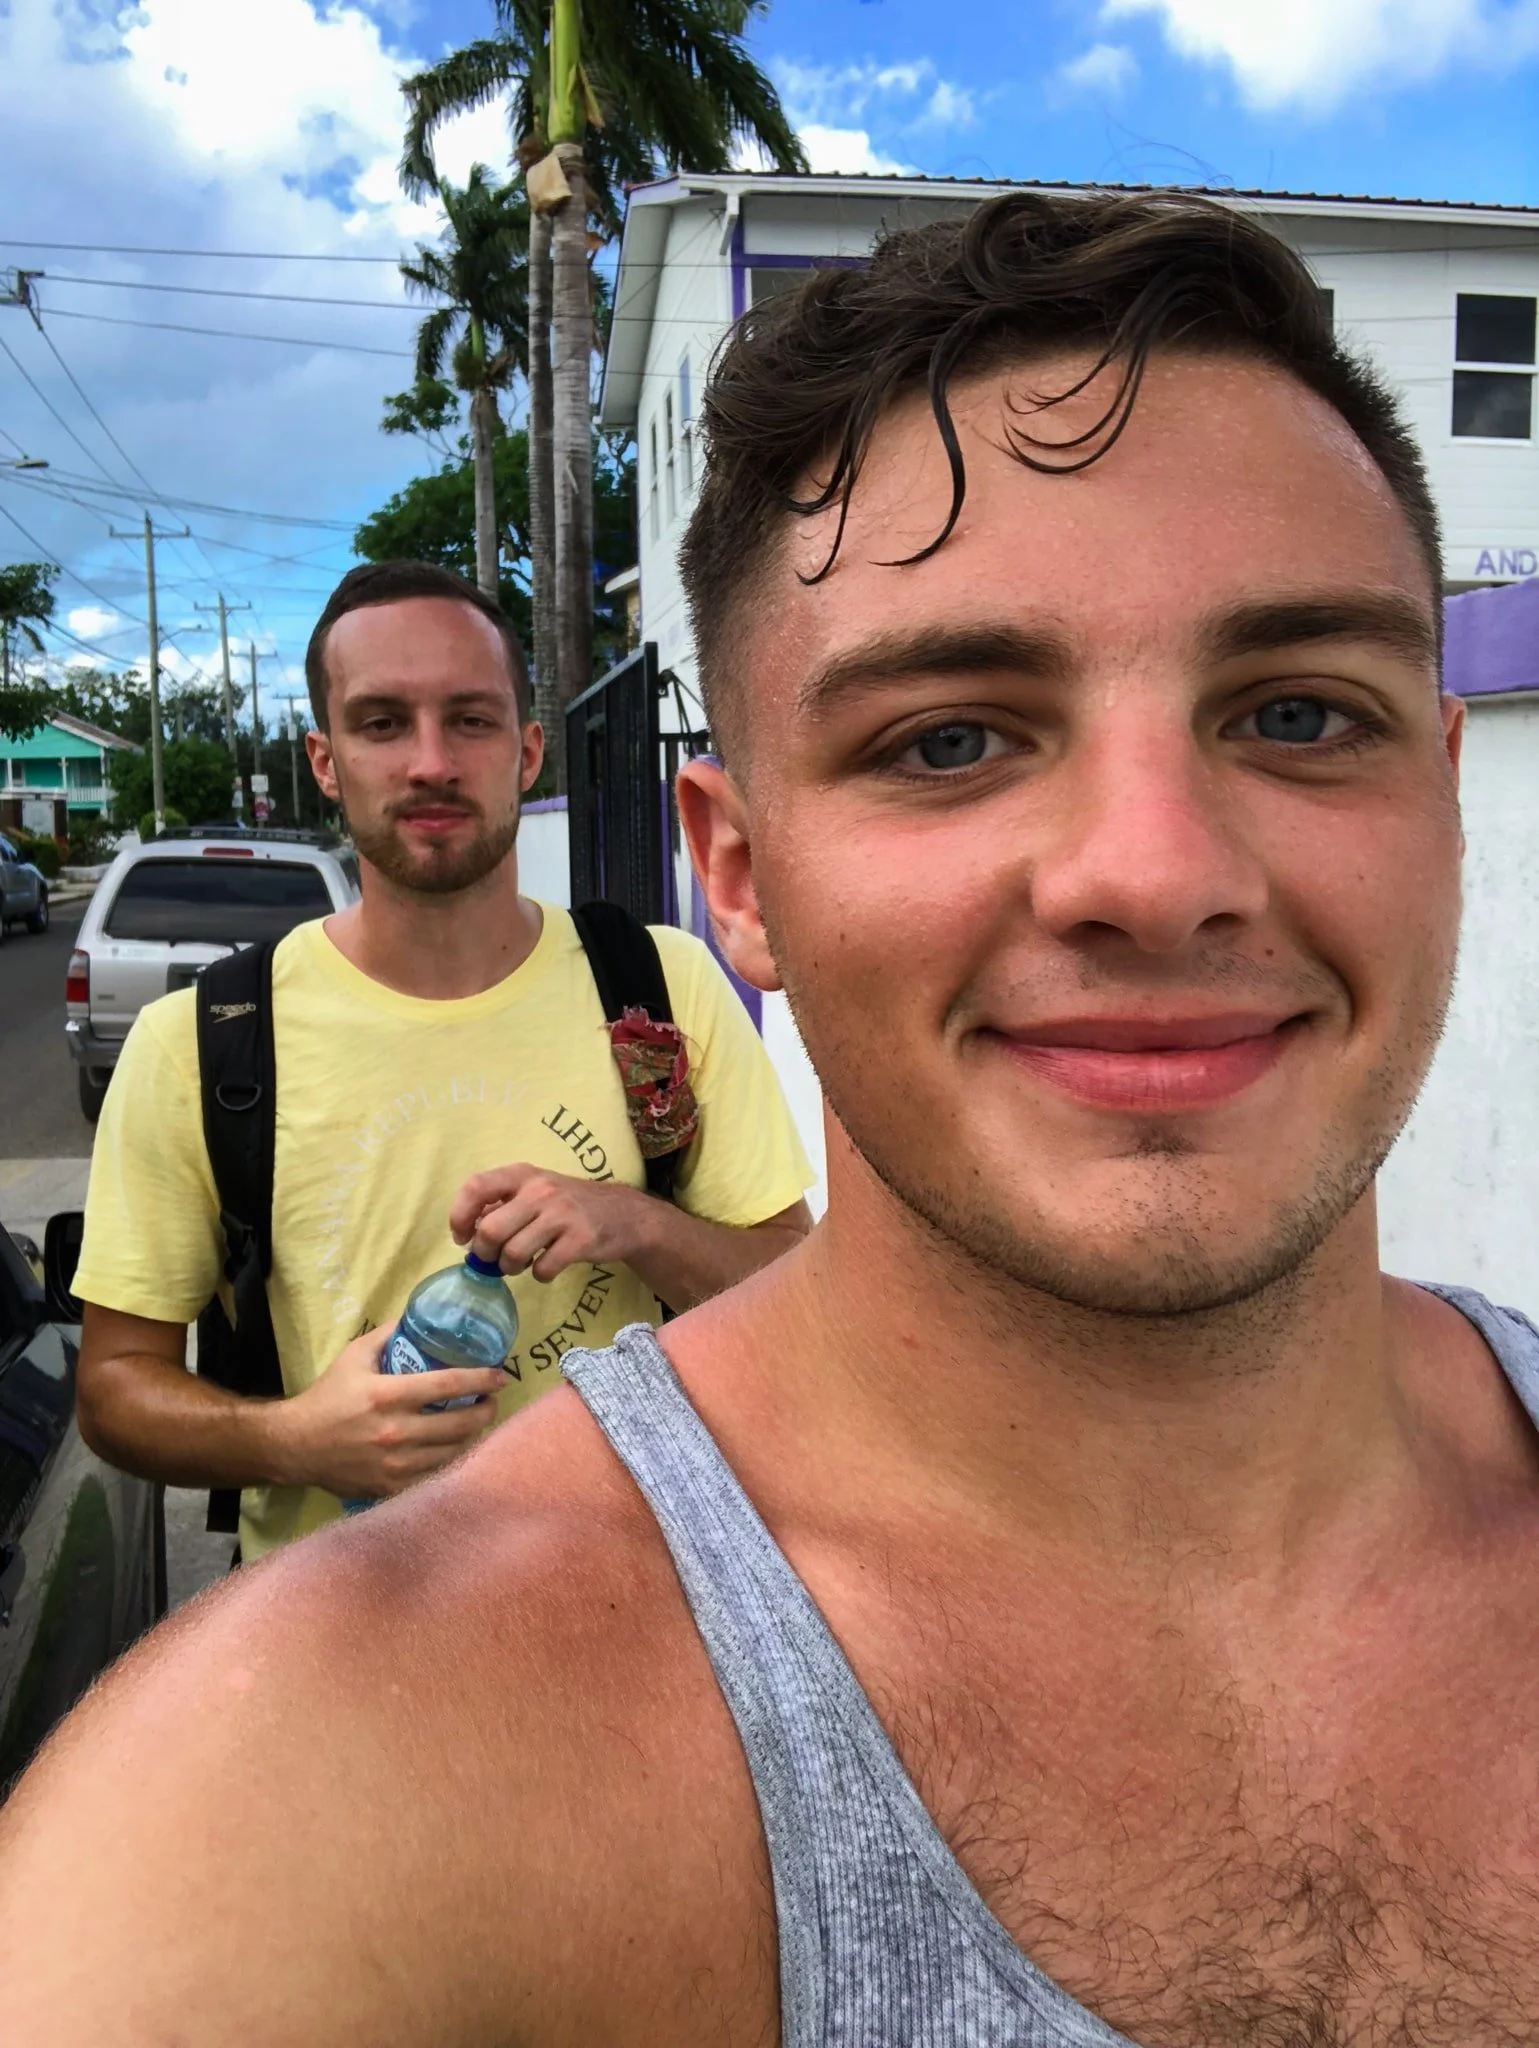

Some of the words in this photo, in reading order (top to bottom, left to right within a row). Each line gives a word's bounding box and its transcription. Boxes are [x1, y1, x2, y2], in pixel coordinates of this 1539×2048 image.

[1474, 549, 1538, 577] AND
[209, 1002, 256, 1015] speedo
[541, 1104, 615, 1182] IGHT
